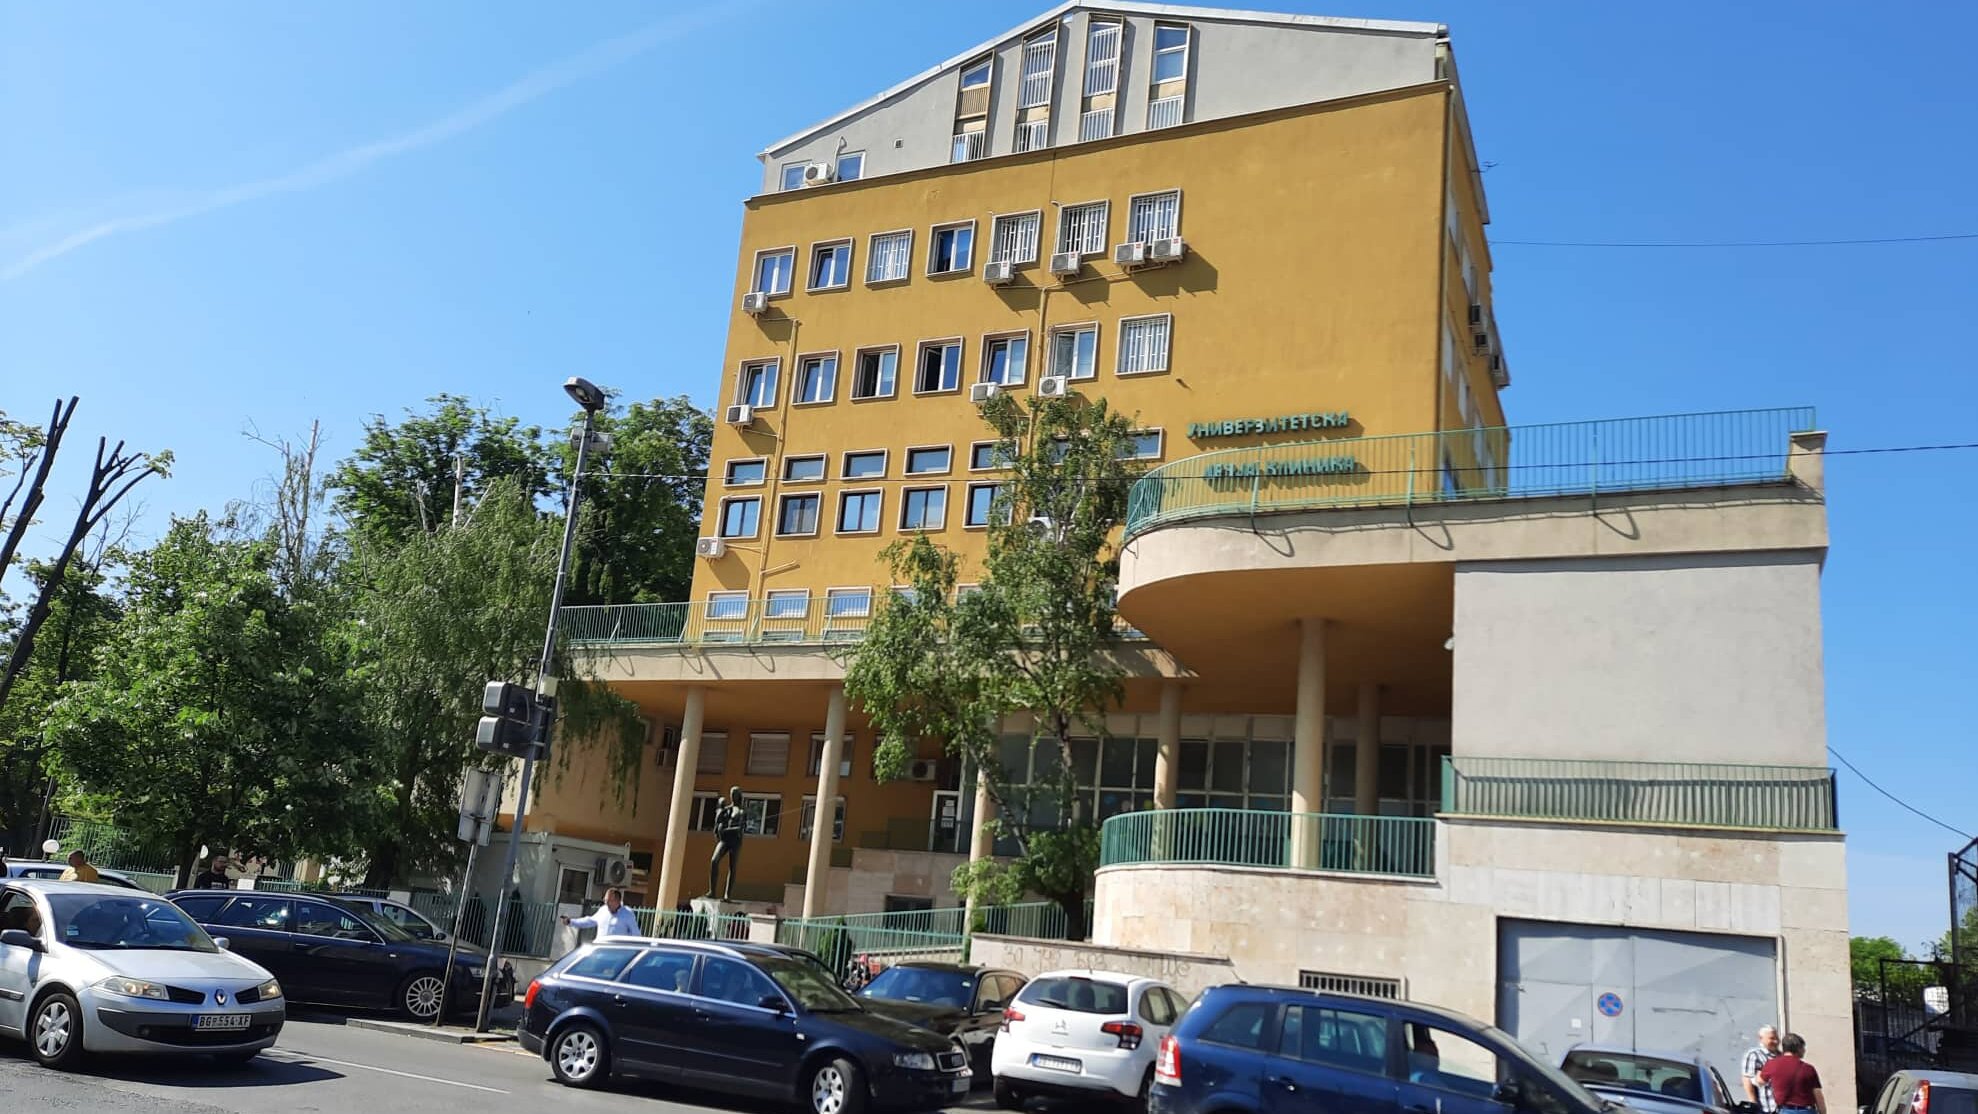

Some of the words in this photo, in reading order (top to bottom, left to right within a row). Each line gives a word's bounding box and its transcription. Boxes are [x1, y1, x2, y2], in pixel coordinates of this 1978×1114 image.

[1187, 411, 1349, 438] УНИВЕРЗИТЕТСКА
[1266, 456, 1355, 476] КЛИНИКА
[199, 1016, 212, 1027] BG
